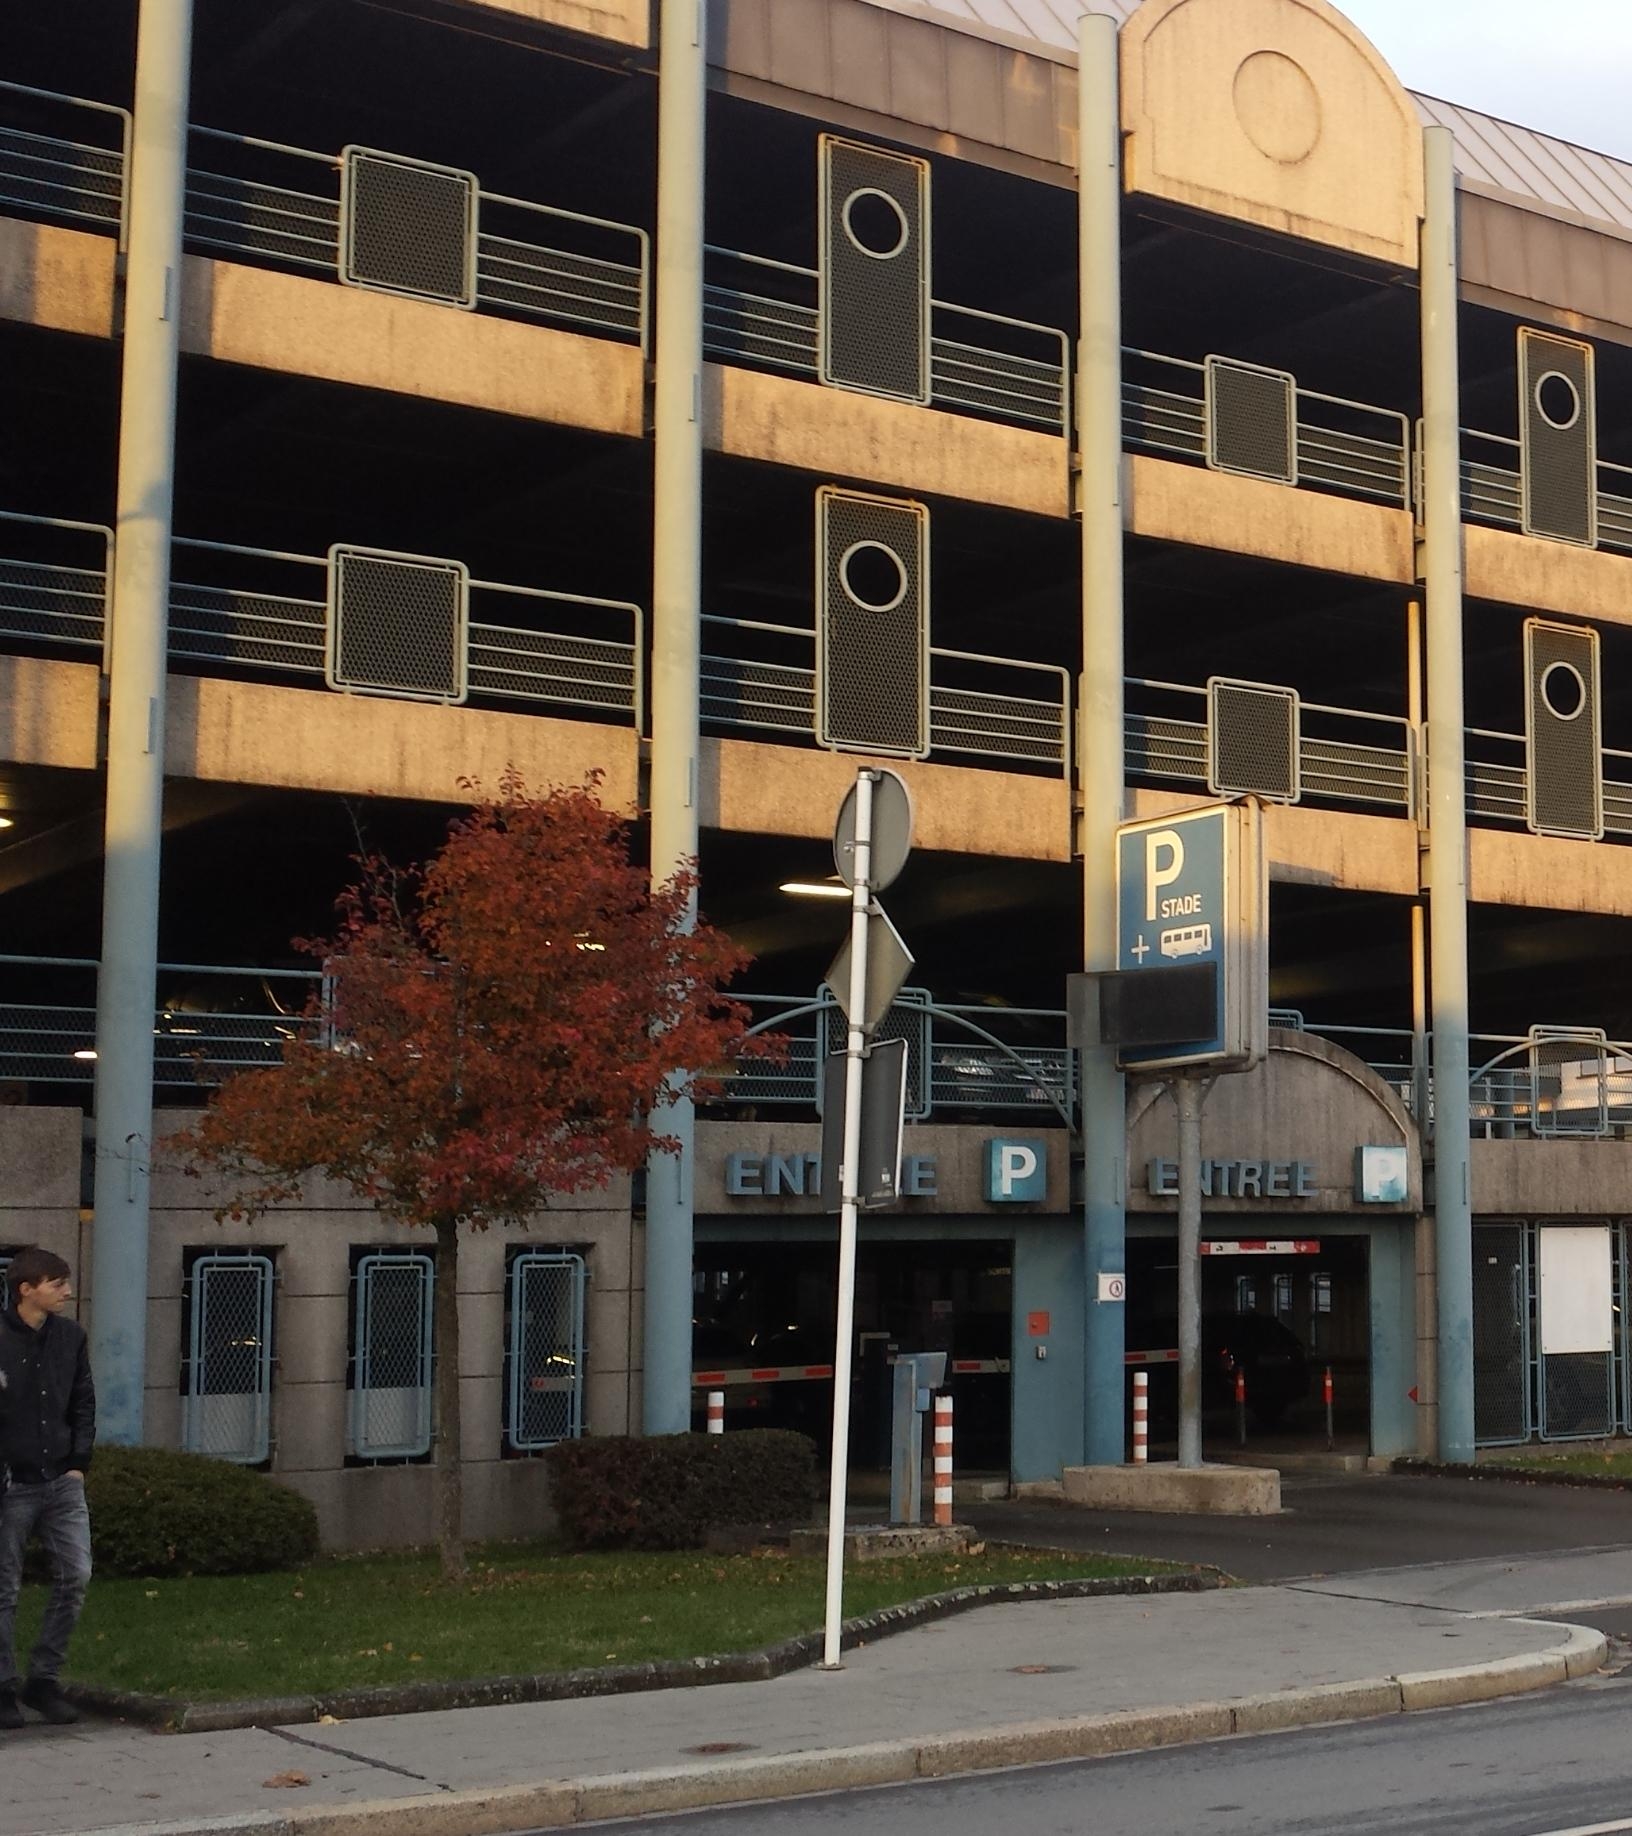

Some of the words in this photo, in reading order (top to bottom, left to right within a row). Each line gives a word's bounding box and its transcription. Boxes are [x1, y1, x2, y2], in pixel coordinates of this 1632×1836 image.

[1147, 830, 1184, 920] P
[1161, 894, 1201, 918] STADE
[727, 1152, 938, 1195] ENTE
[1001, 1145, 1038, 1195] P
